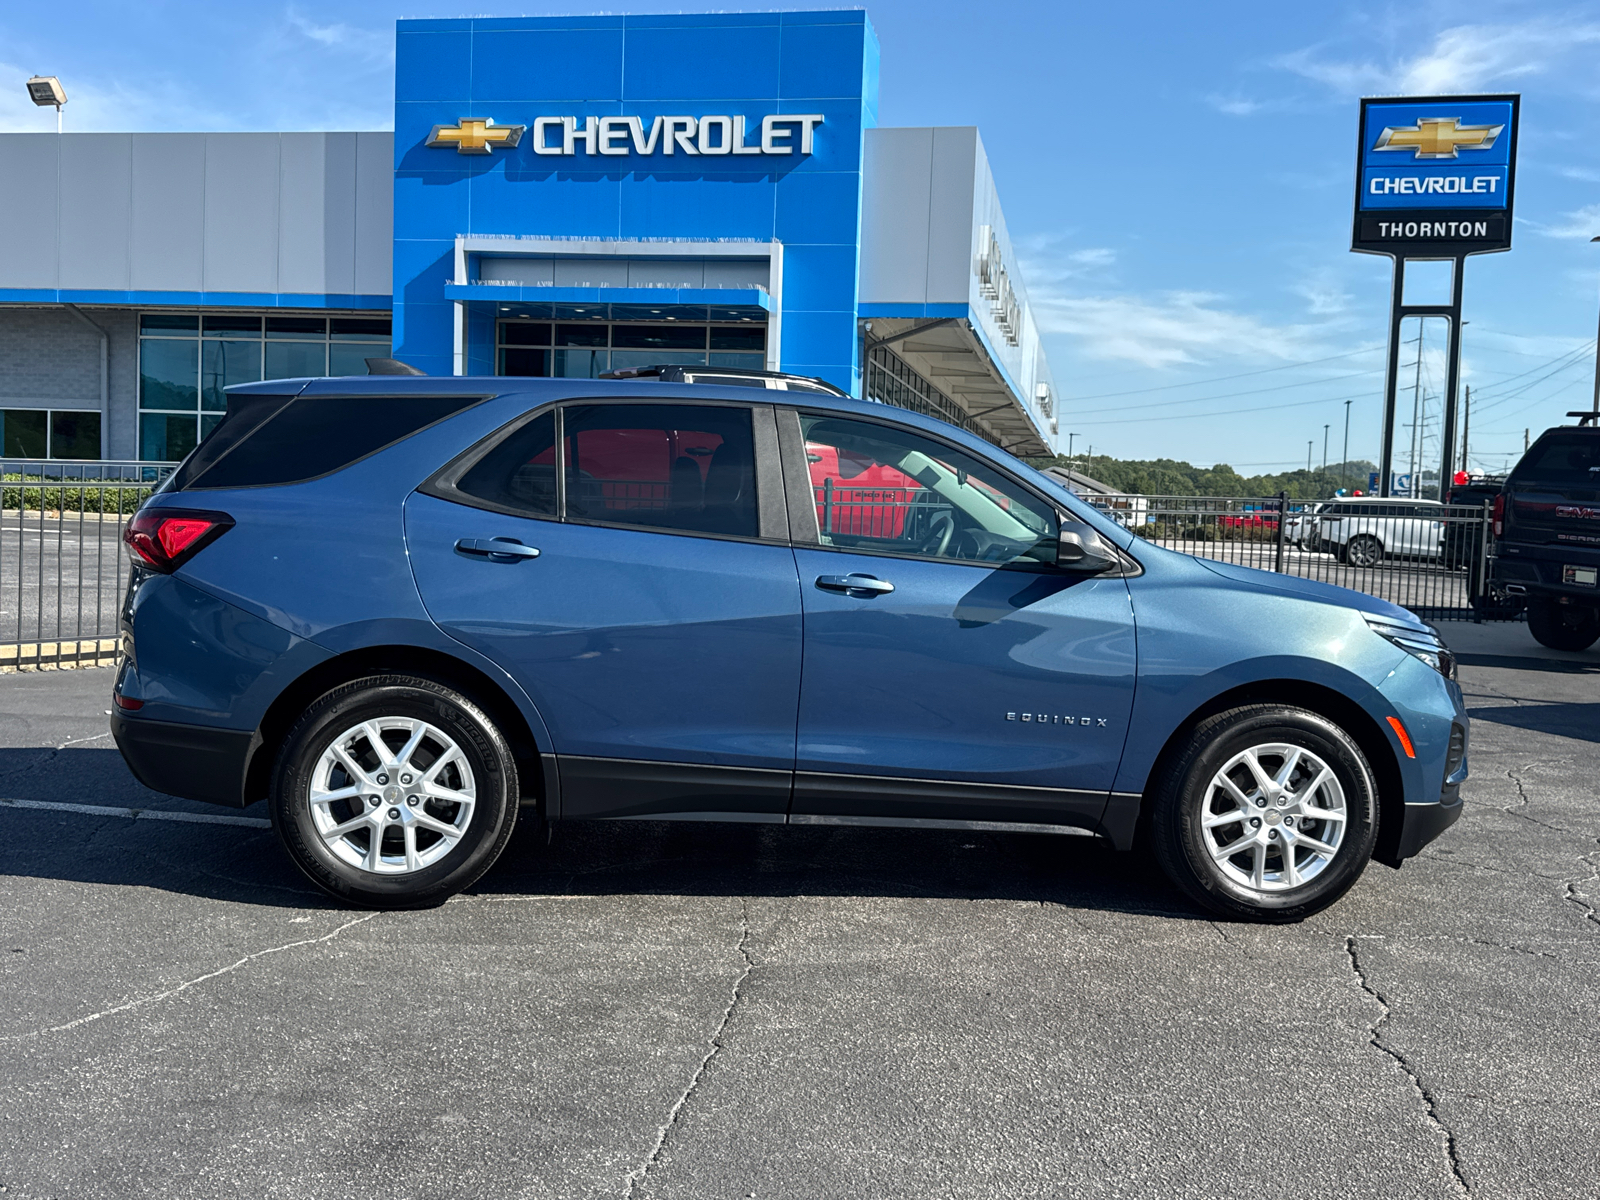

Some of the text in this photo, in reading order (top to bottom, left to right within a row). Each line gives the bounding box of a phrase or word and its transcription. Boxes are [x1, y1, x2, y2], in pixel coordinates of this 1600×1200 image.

[533, 114, 825, 156] CHEVROLET
[1370, 176, 1500, 194] CHEVROLET
[1378, 221, 1487, 237] THORNTON
[1555, 505, 1600, 520] GMC
[1006, 711, 1107, 727] EQUINOX
